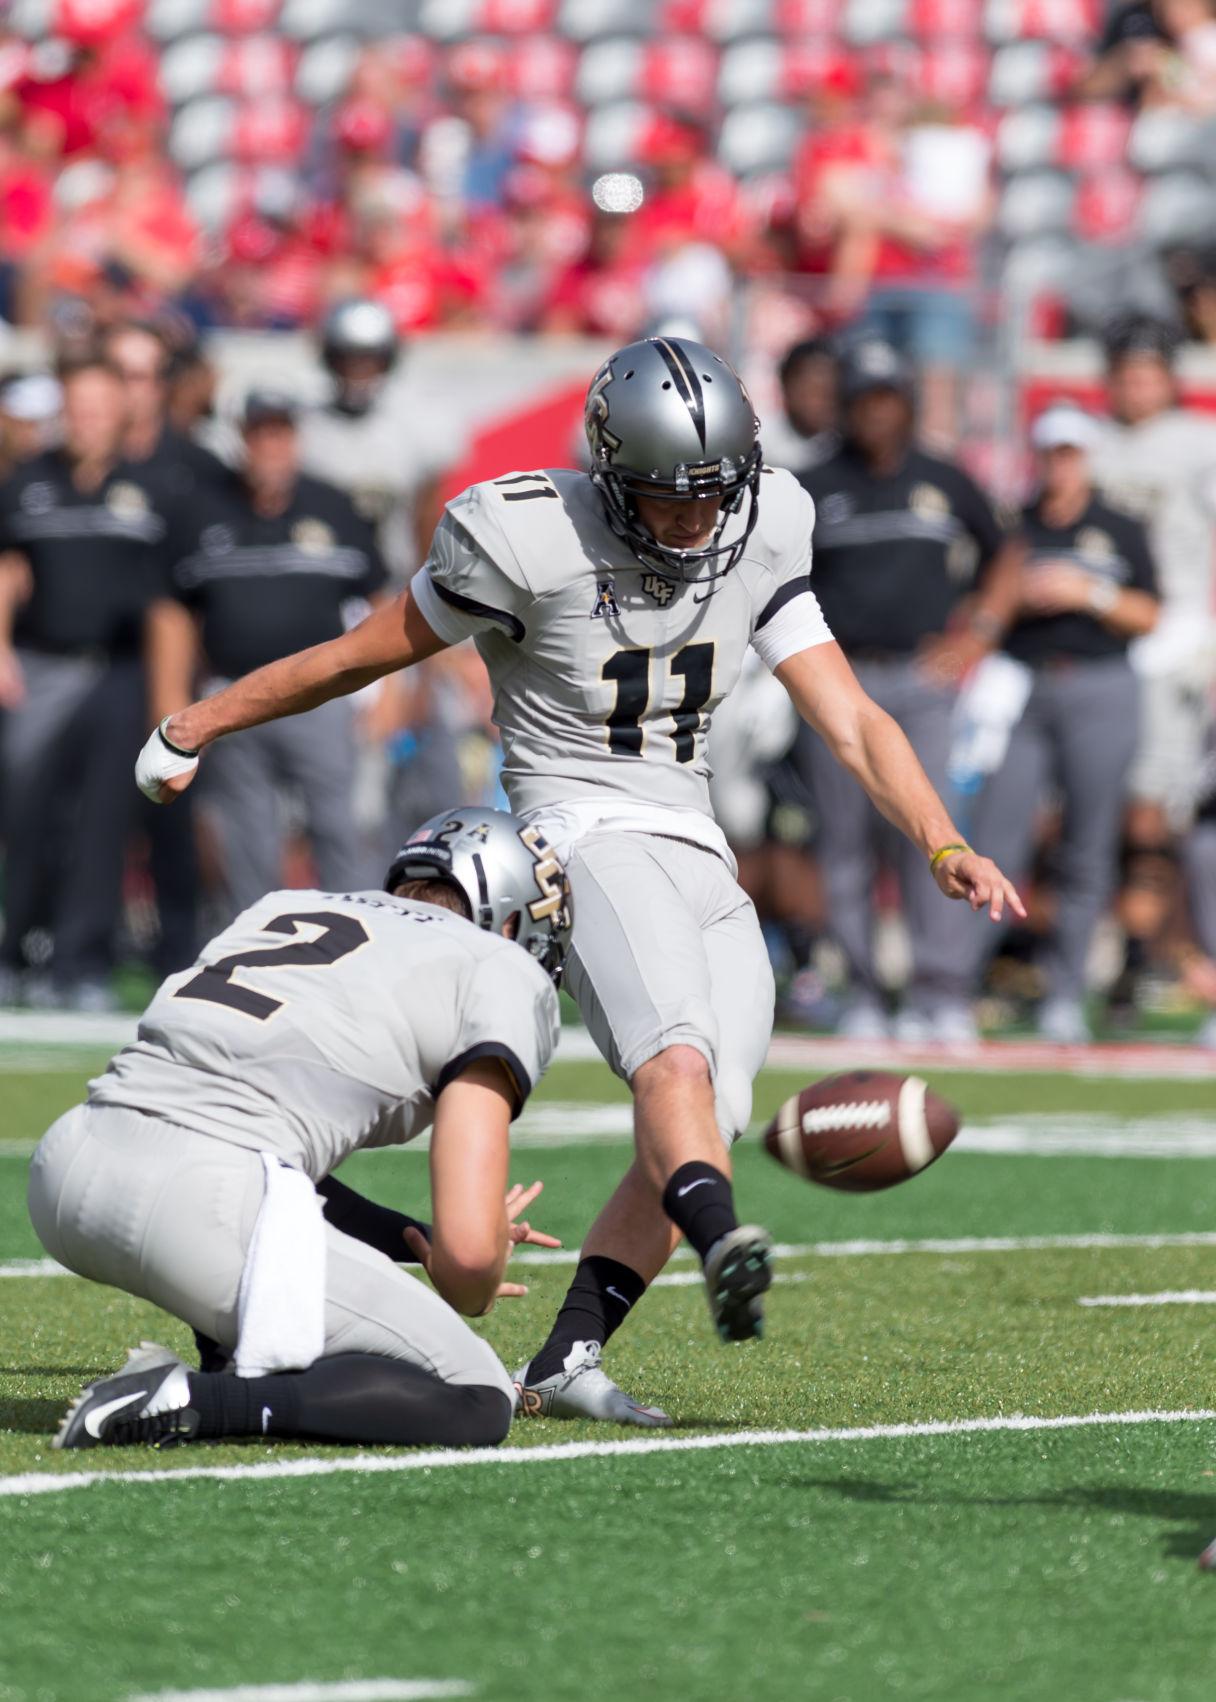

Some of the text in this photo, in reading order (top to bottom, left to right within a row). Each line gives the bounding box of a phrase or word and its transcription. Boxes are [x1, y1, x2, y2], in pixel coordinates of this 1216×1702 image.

[493, 474, 560, 502] 11
[590, 581, 621, 619] A
[640, 573, 676, 607] UCF
[599, 640, 719, 764] 11
[433, 820, 464, 847] 2
[172, 911, 373, 1024] 2
